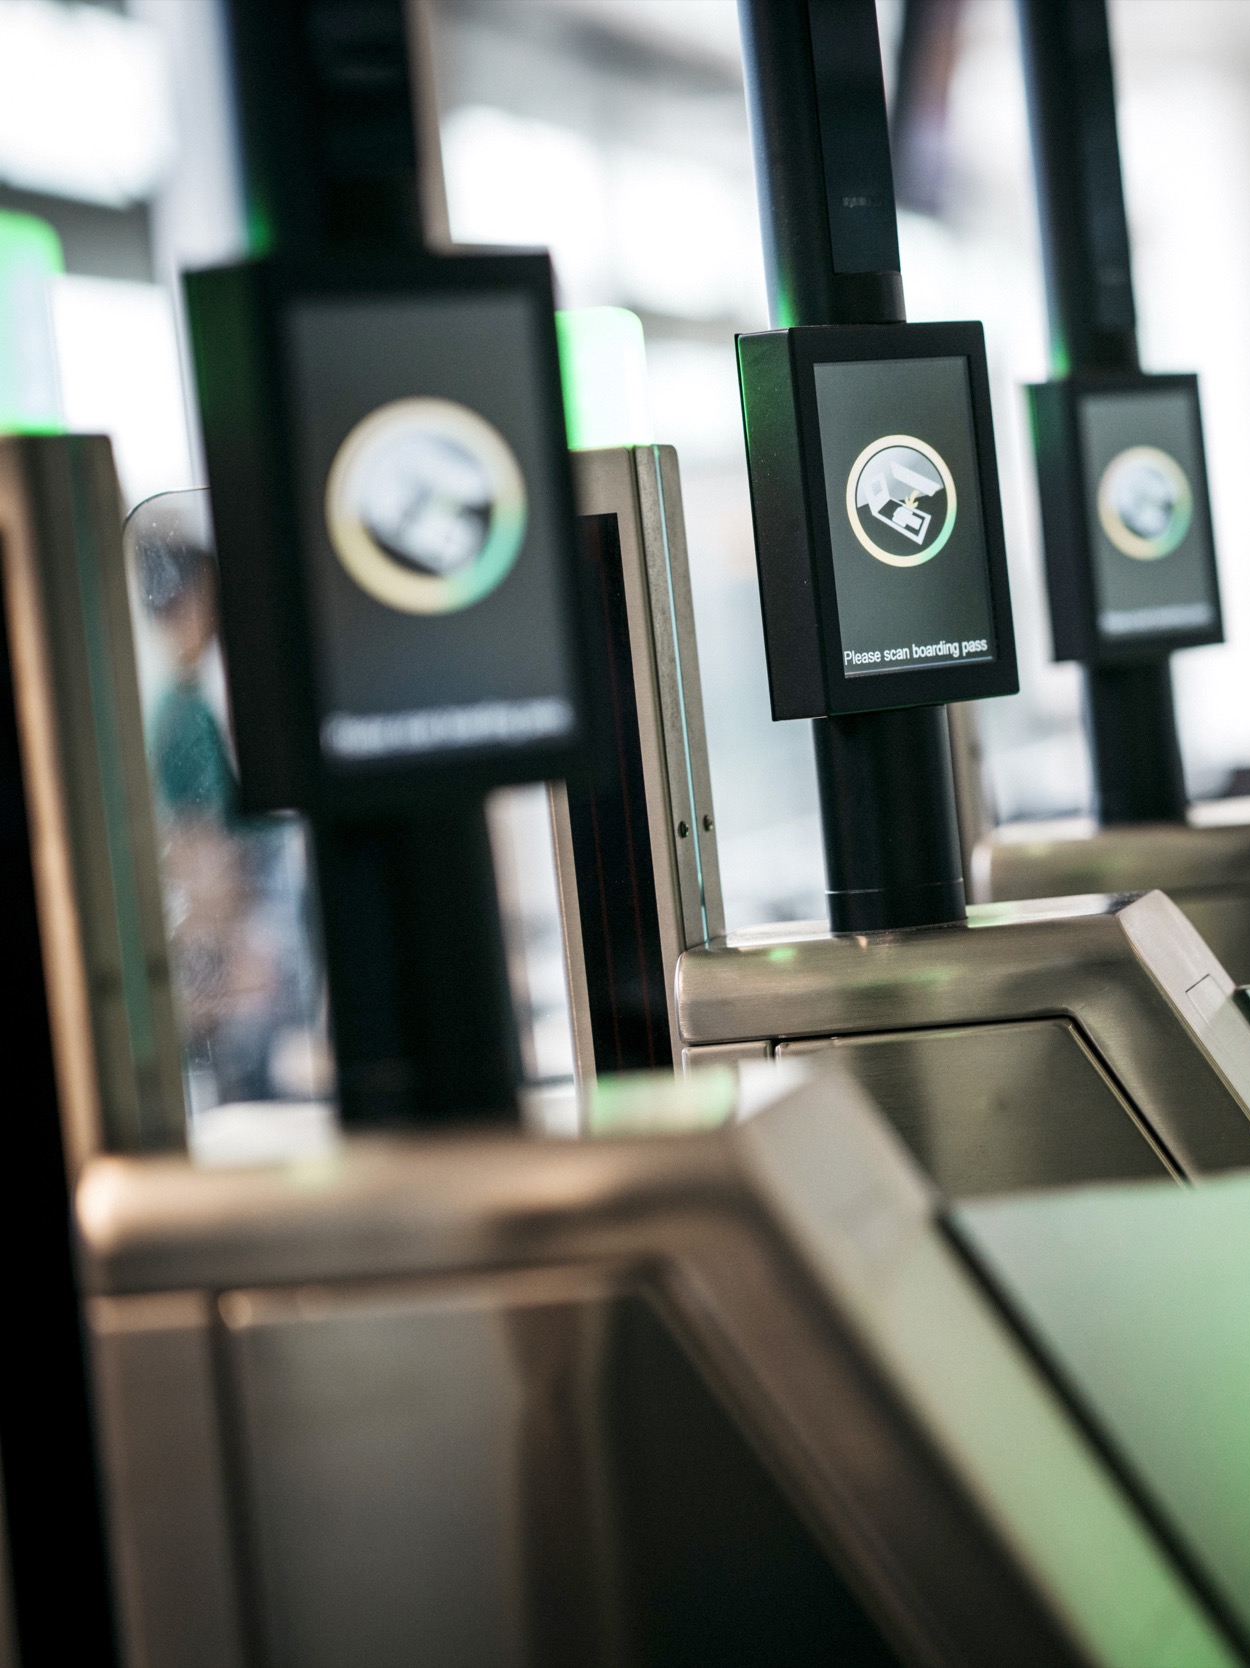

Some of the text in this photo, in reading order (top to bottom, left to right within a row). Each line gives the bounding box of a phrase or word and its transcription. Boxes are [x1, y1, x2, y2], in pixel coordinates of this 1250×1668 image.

[843, 639, 988, 666] Please scan boarding pass
